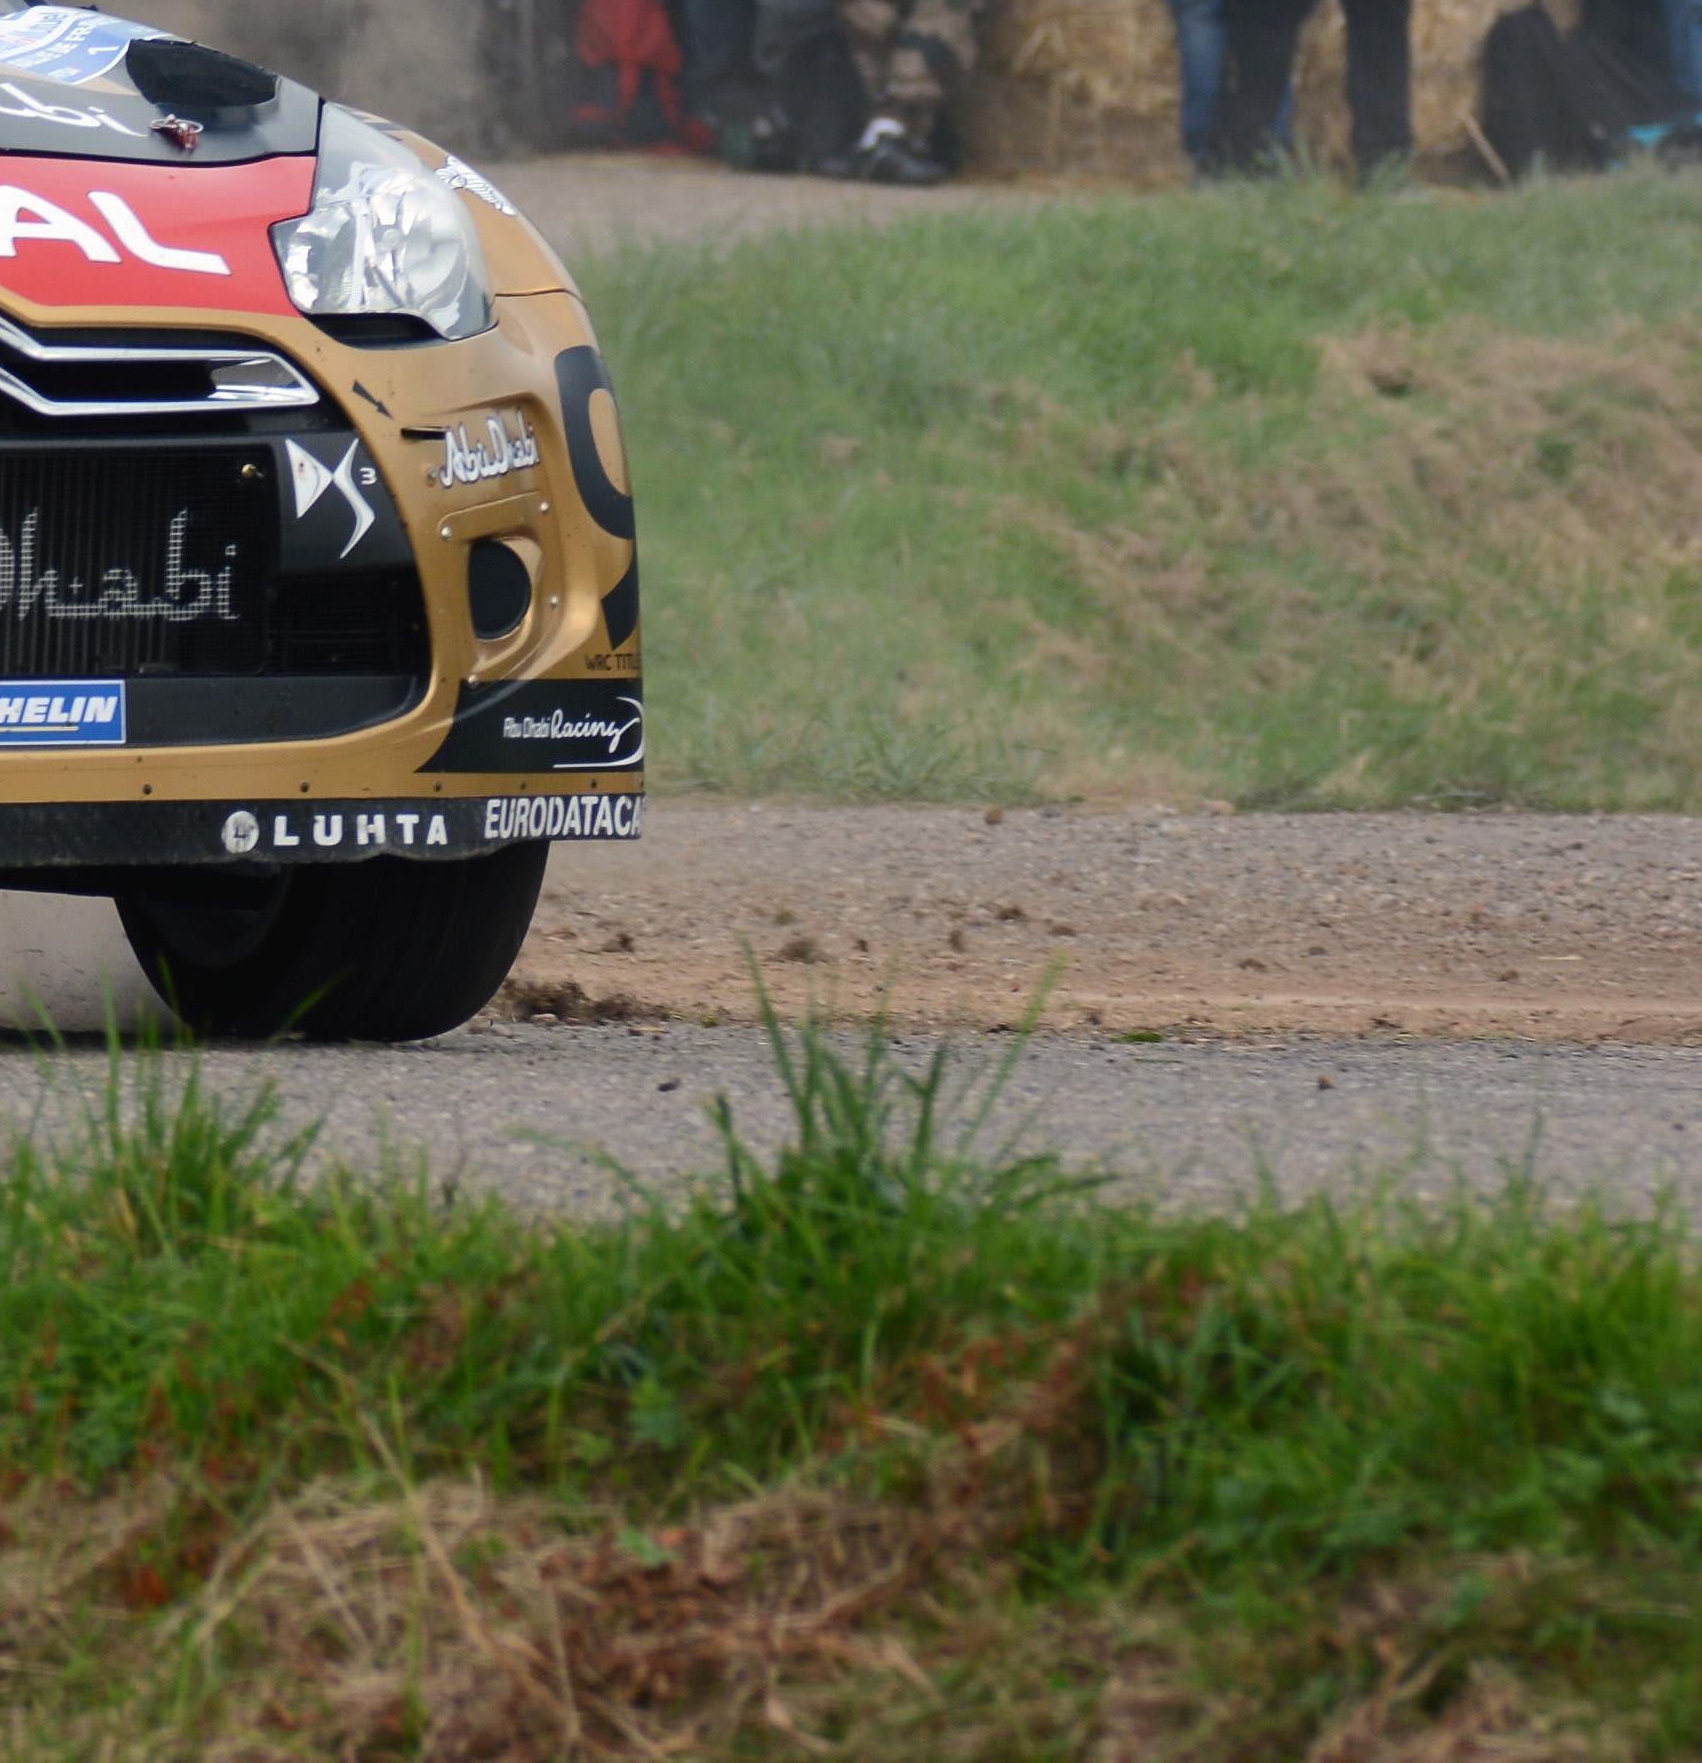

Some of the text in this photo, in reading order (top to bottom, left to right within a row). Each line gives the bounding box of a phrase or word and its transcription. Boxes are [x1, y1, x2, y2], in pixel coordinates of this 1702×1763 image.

[584, 653, 612, 671] WRC
[551, 708, 641, 754] Racing
[273, 813, 449, 847] LUHTA
[483, 795, 645, 840] EURODATACA
